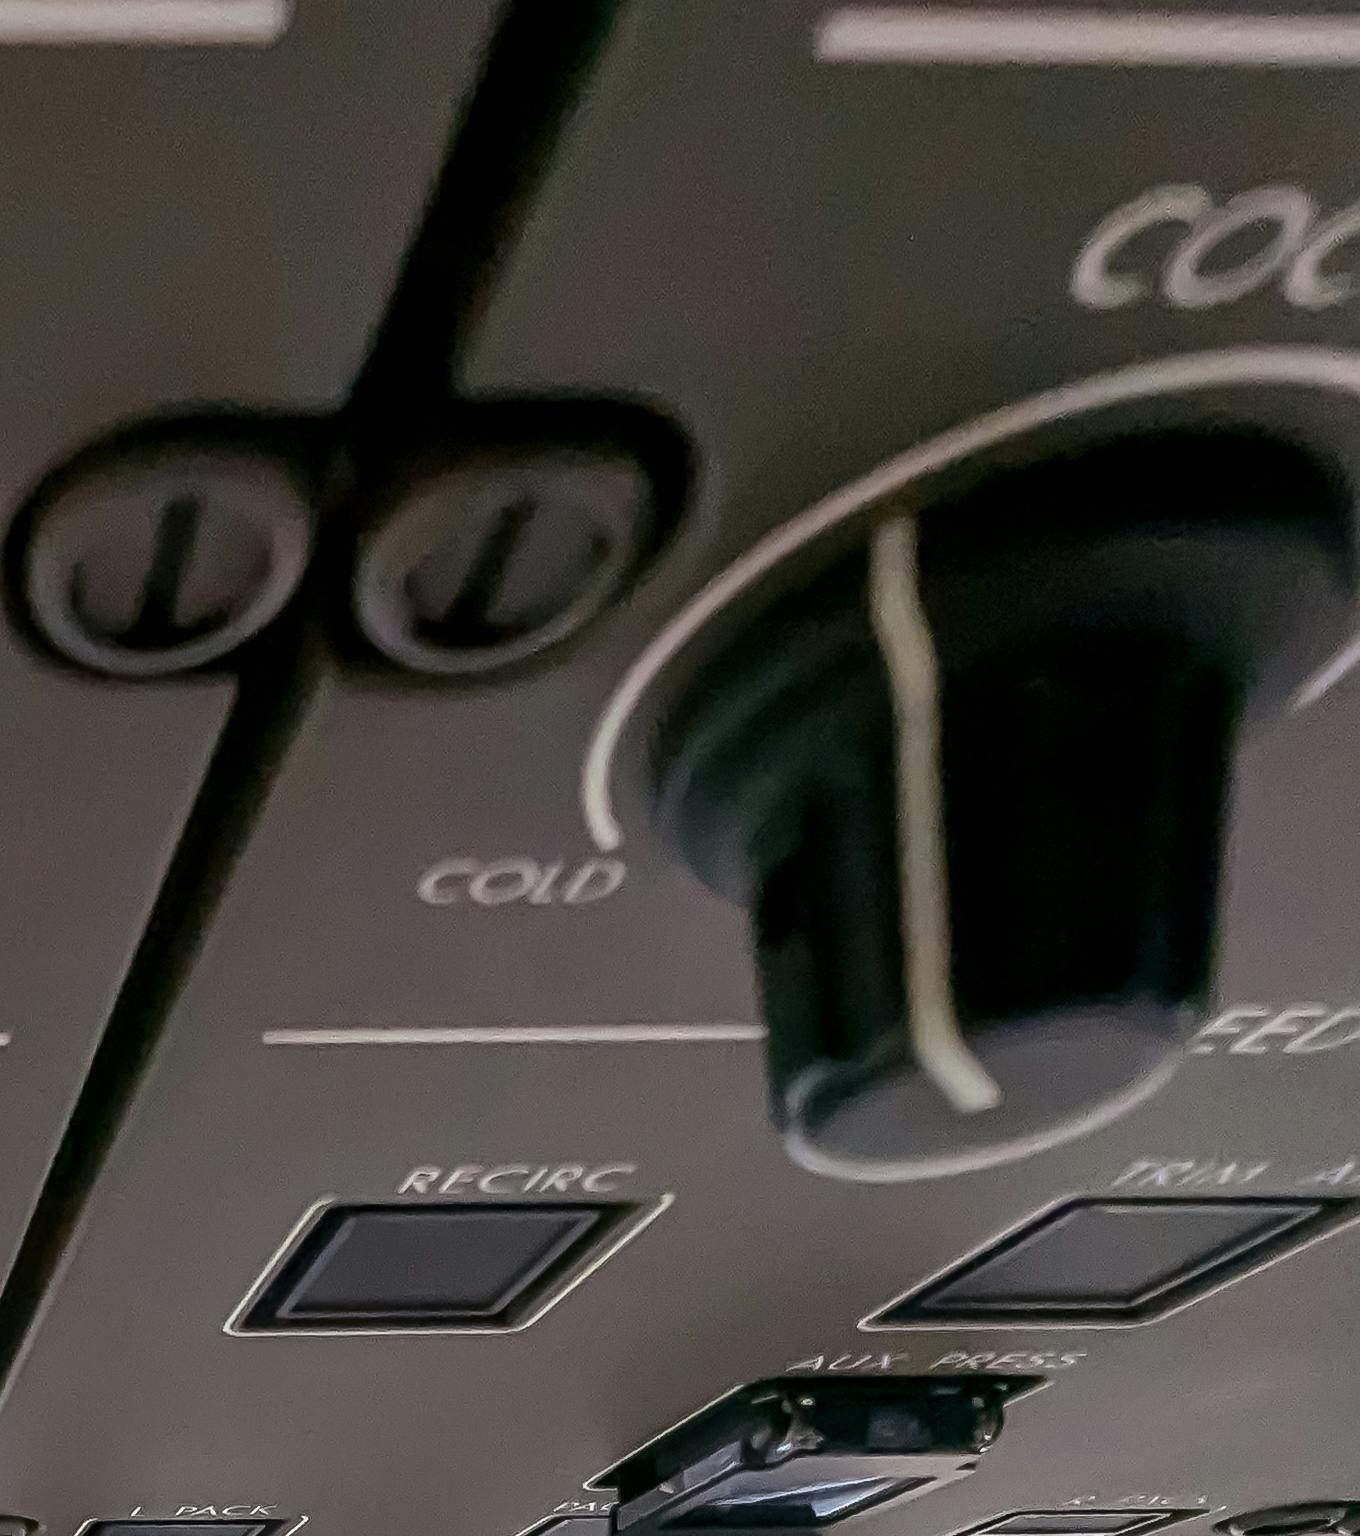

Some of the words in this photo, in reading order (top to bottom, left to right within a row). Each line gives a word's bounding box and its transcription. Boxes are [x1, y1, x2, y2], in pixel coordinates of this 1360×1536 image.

[417, 855, 628, 907] COLD
[397, 1164, 640, 1196] RECIRC
[930, 1350, 1088, 1371] PRESS
[130, 1505, 146, 1518] L
[175, 1503, 279, 1518] PACK
